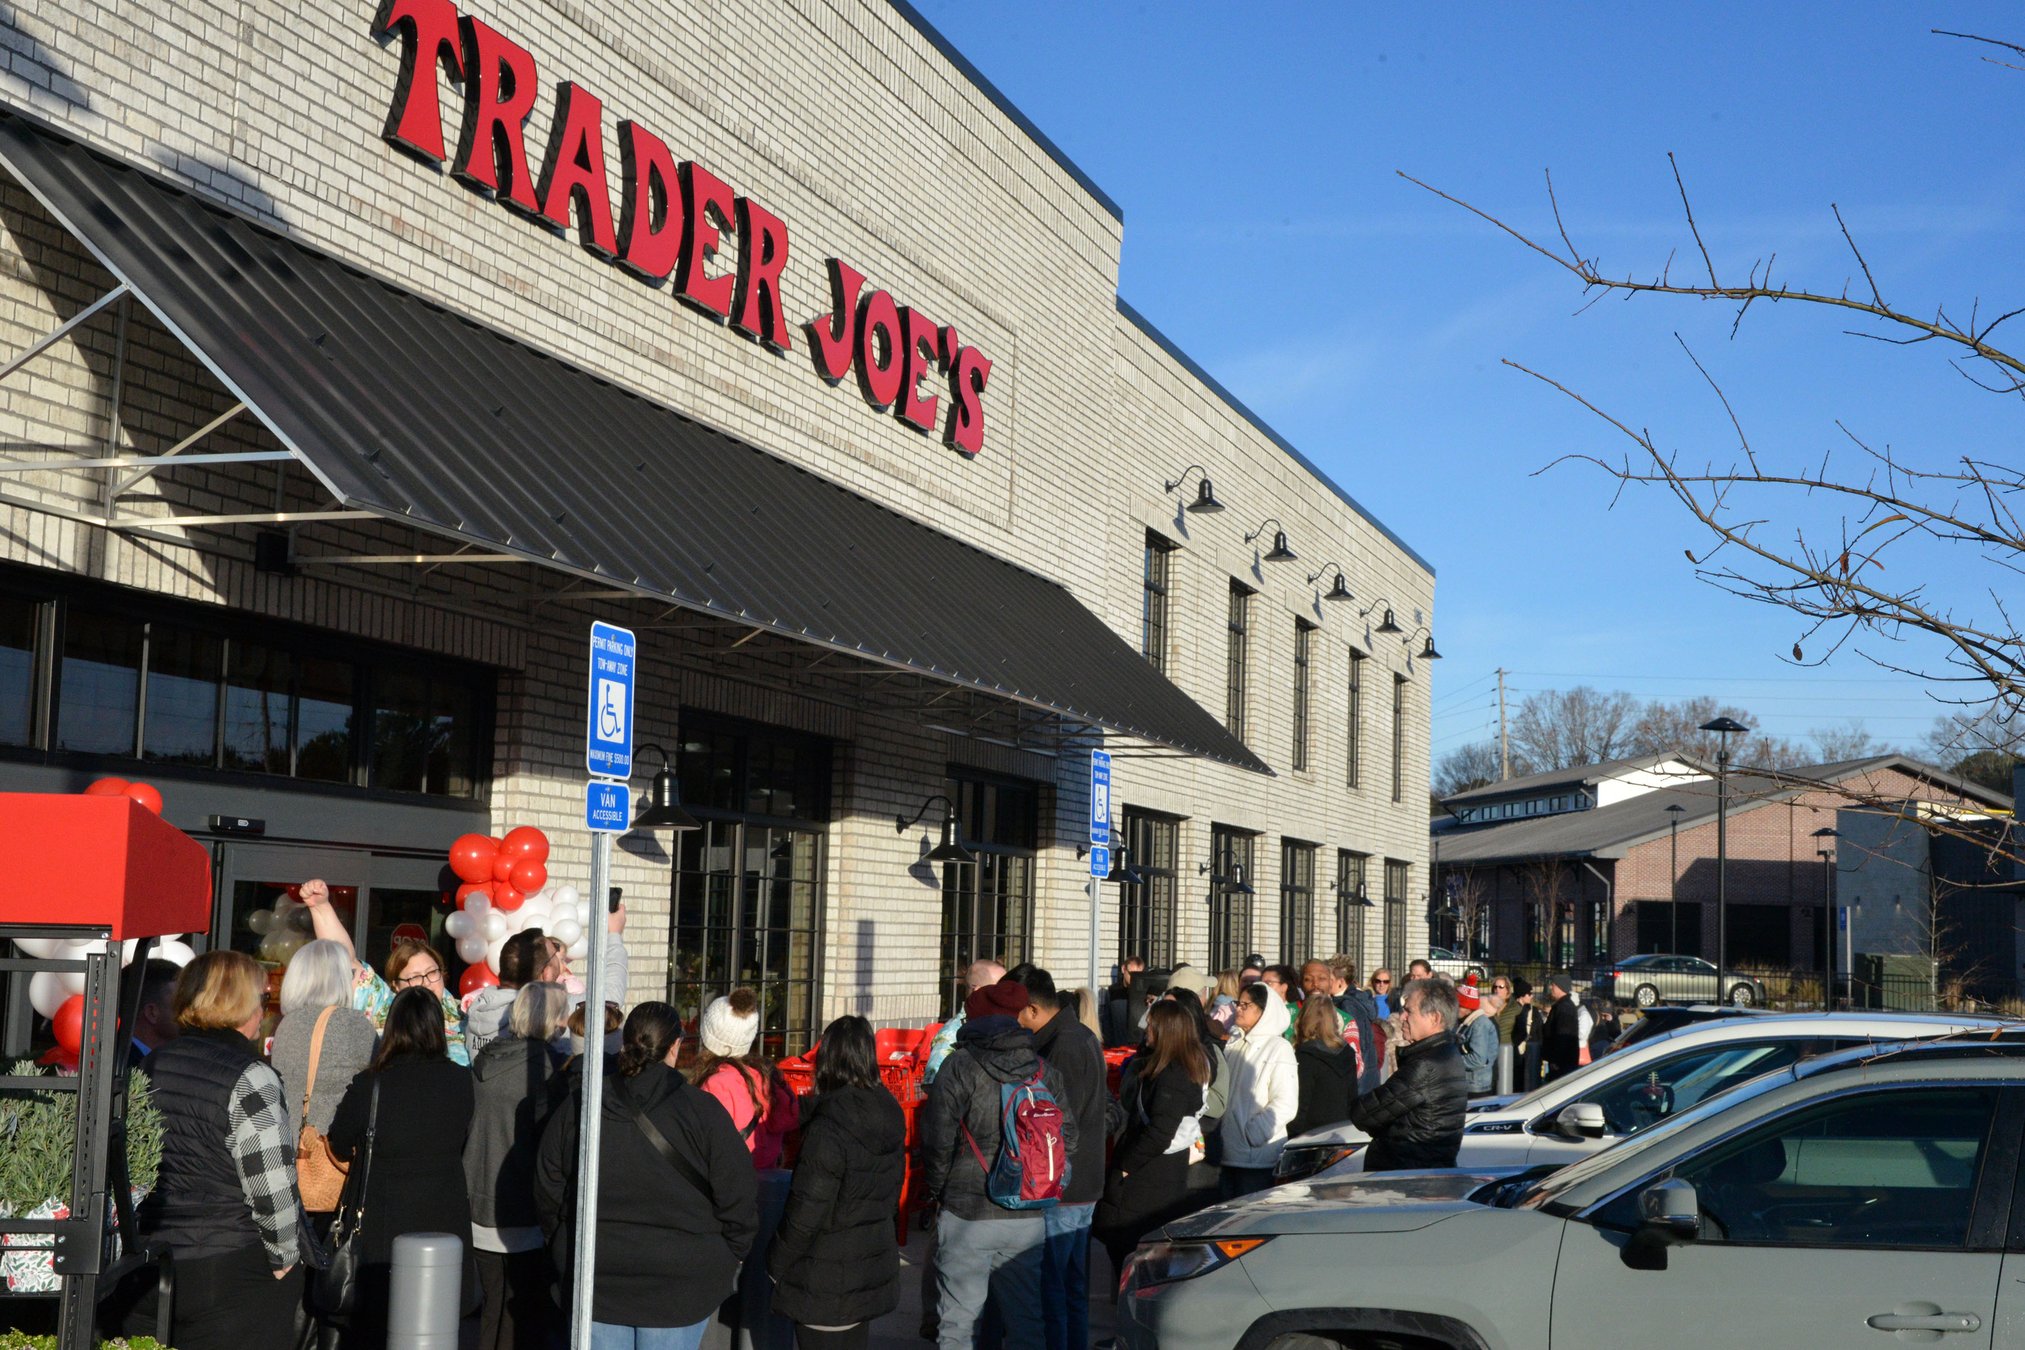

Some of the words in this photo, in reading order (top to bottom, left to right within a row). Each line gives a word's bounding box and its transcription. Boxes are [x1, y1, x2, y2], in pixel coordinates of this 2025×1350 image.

[372, 0, 792, 352] TRADER
[802, 258, 993, 457] JOE'S
[592, 635, 607, 650] PERMIT
[624, 644, 634, 658] ONLY
[617, 662, 628, 676] ZONE
[600, 793, 616, 808] VAN
[592, 809, 623, 821] ACCESSIBLE
